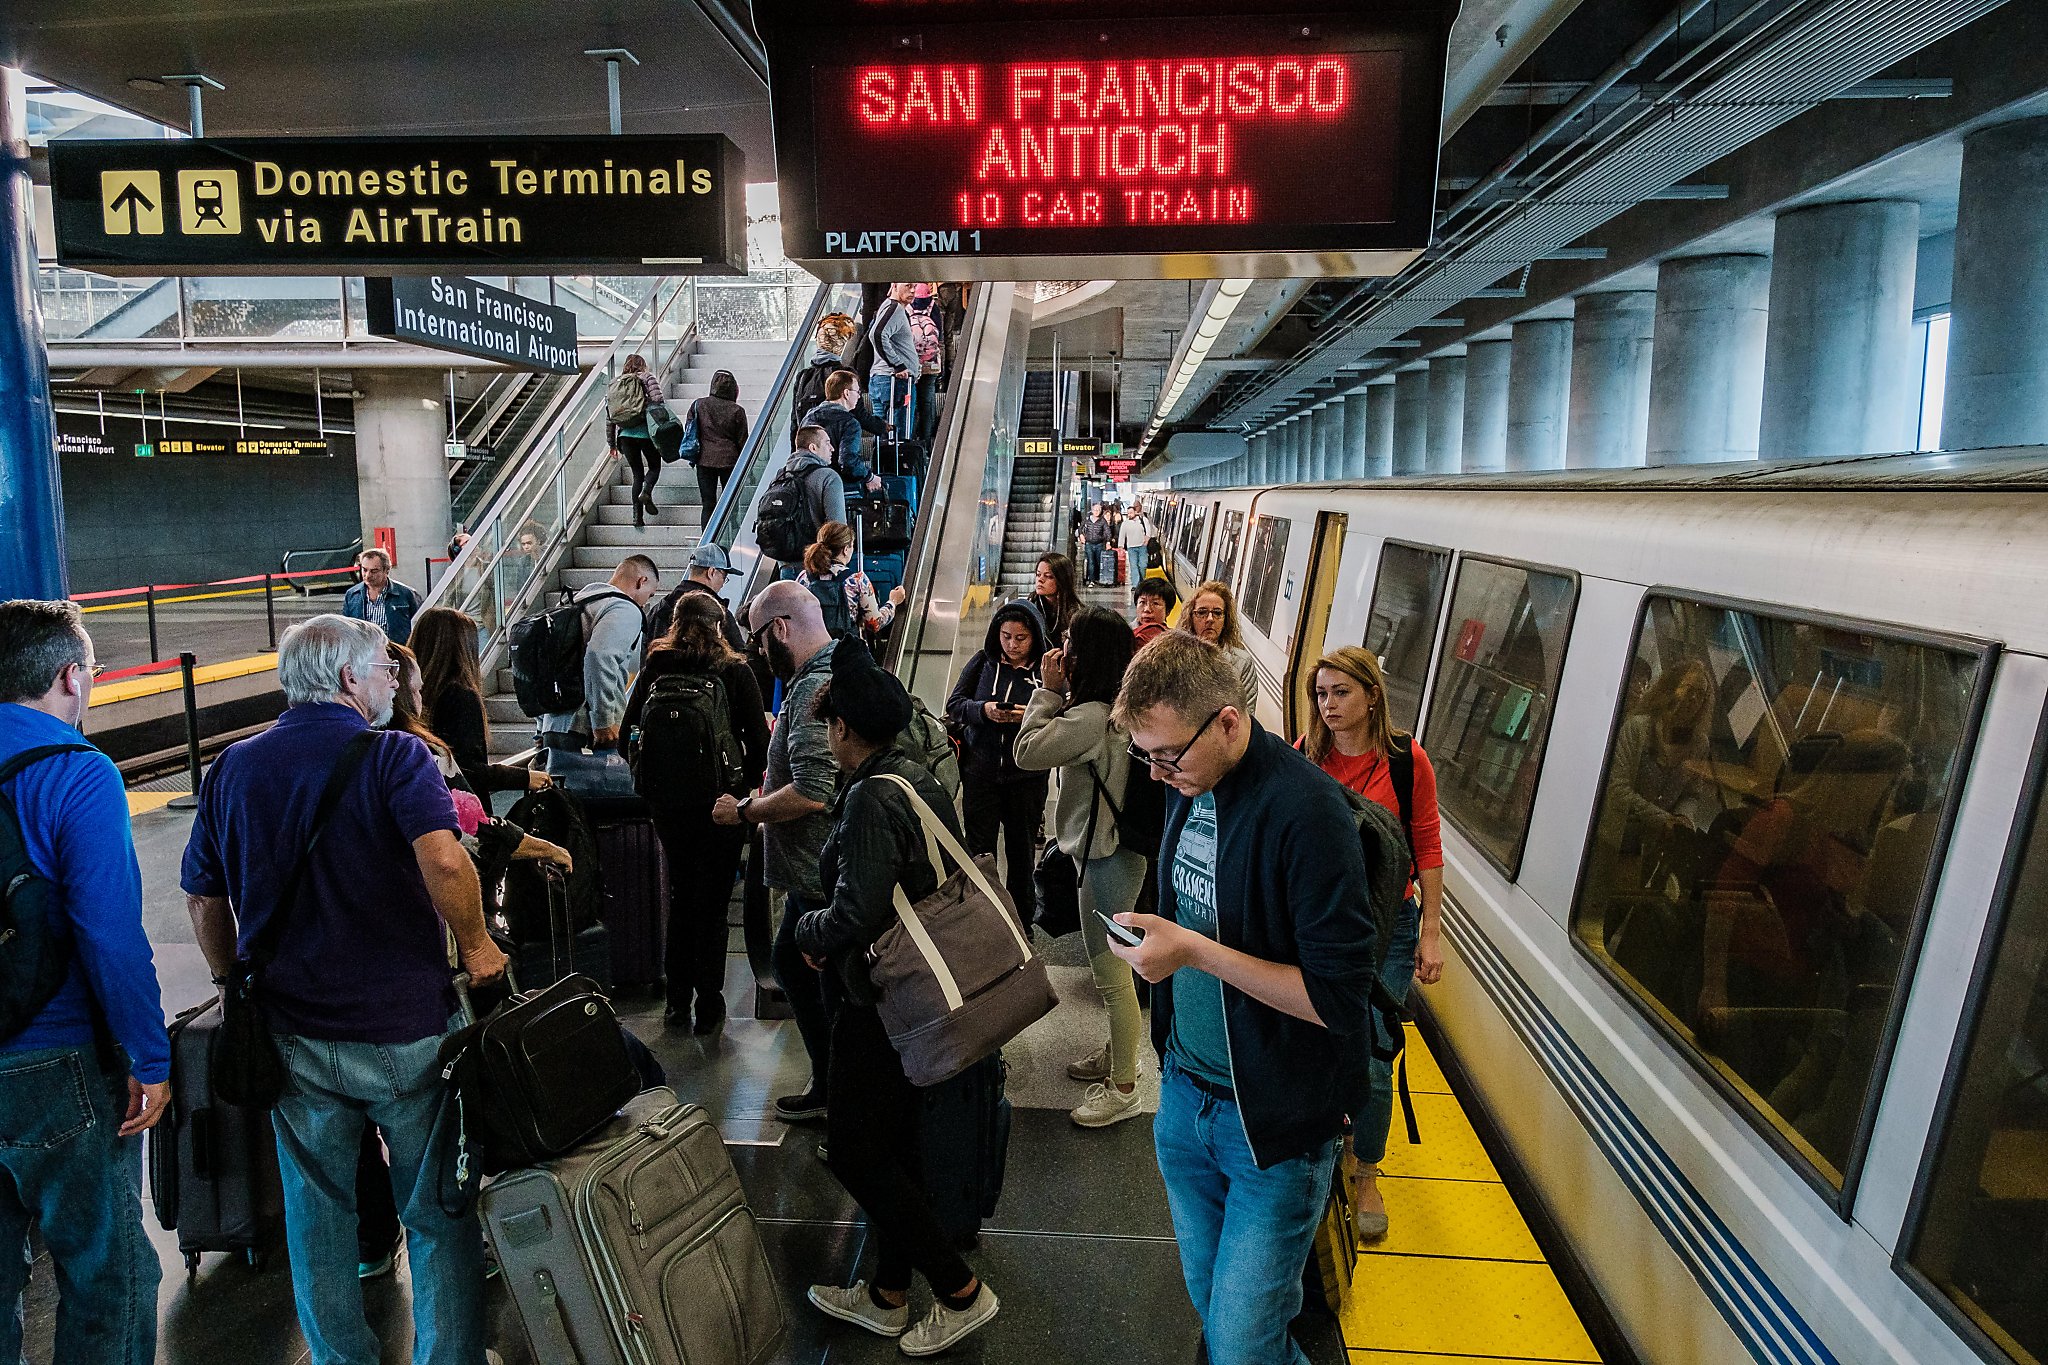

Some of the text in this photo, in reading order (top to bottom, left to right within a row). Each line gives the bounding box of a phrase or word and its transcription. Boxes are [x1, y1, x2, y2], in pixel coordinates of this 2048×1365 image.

[862, 61, 1344, 121] SAN FRANCISCO
[979, 124, 1225, 178] ANTIOCH
[255, 159, 712, 196] Domestic Terminals
[960, 189, 1247, 222] 10 CAR TRAIN
[256, 207, 521, 243] via AirTrain
[825, 230, 981, 253] PLATFORM 1
[431, 276, 553, 335] San Francisco
[396, 298, 578, 370] International Airport
[63, 433, 102, 446] Francisco
[88, 444, 115, 456] Airport
[195, 443, 225, 452] Elevator
[259, 440, 327, 448] Domestic Terminals
